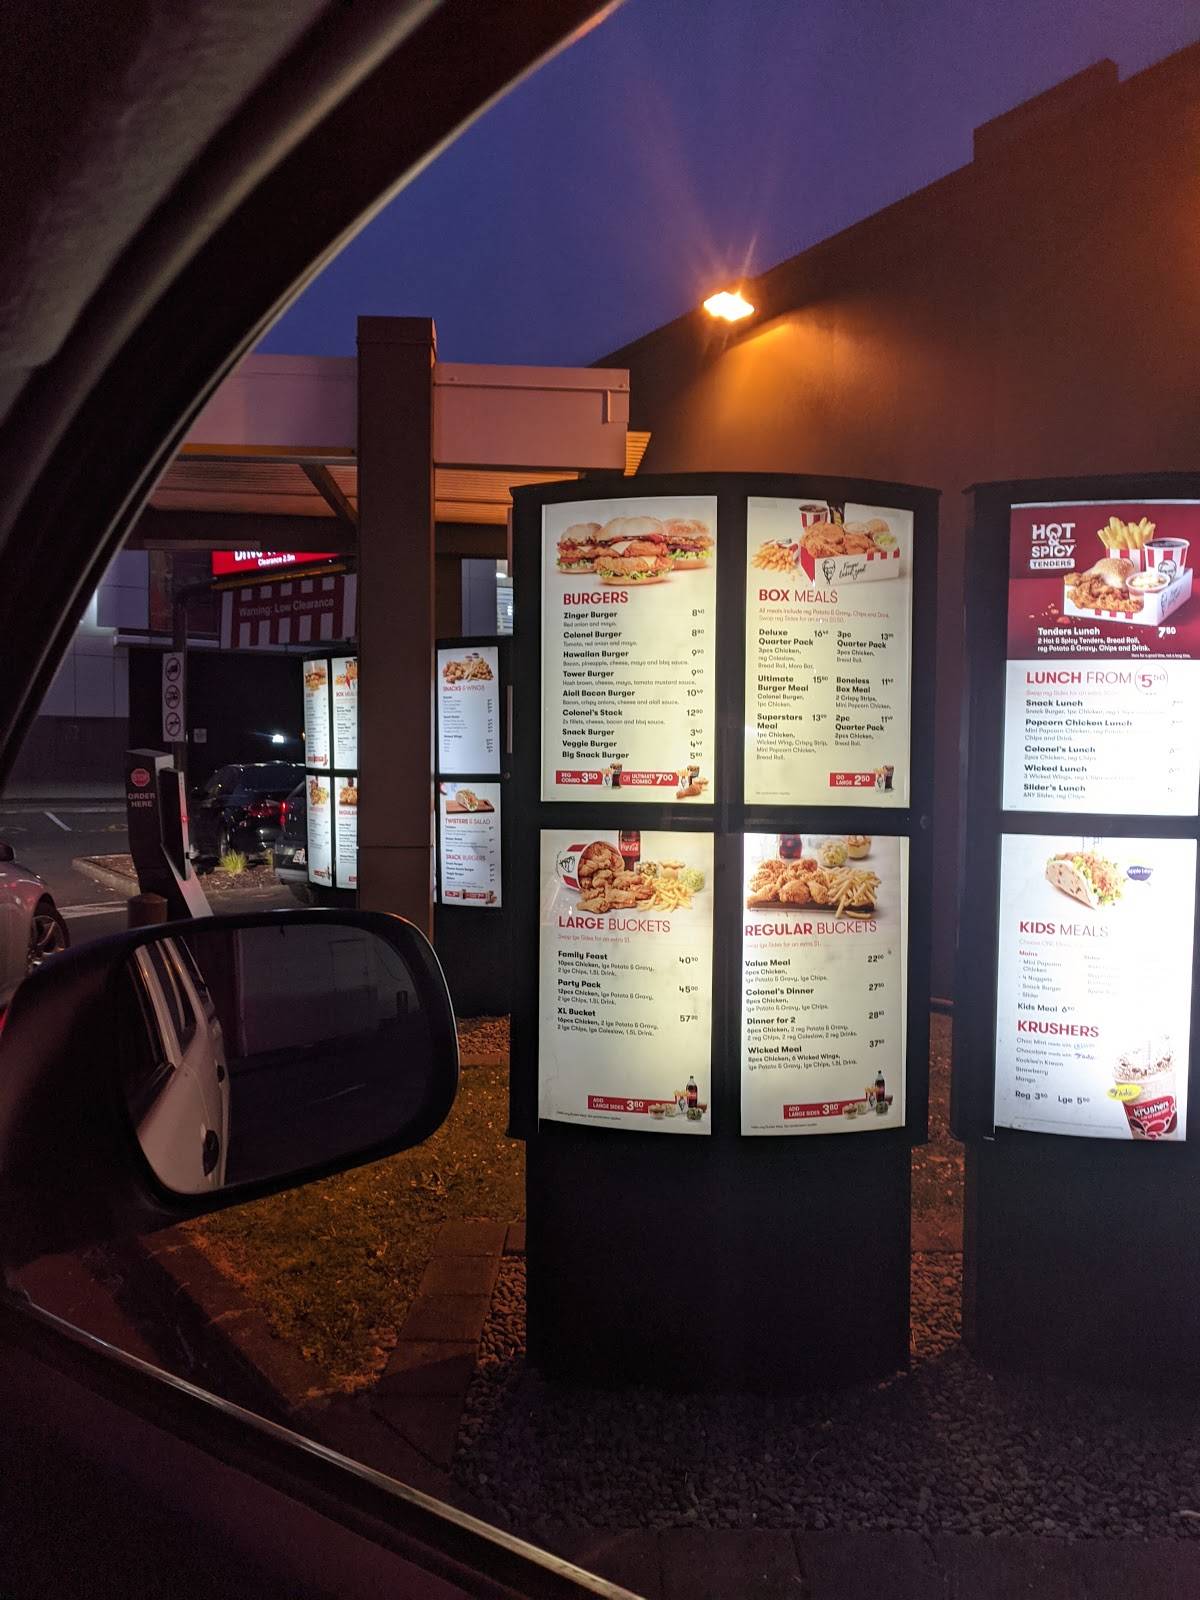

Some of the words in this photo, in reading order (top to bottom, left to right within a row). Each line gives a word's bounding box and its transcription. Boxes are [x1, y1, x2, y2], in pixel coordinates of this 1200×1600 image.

[1032, 523, 1075, 540] HOT
[1048, 532, 1060, 546] &
[1032, 545, 1074, 558] SPICY
[258, 555, 282, 566] Clearance
[563, 591, 629, 606] BURGERS
[759, 589, 790, 601] BOX
[794, 590, 838, 603] MEALS
[240, 606, 272, 617] Warning:
[274, 603, 292, 614] Low
[293, 598, 334, 610] Clearance
[602, 650, 629, 658] Burger
[588, 670, 614, 678] Burger
[1026, 672, 1081, 684] LUNCH
[1086, 672, 1131, 684] FROM
[1026, 719, 1063, 727] Popcorn
[559, 916, 604, 930] LARGE
[609, 918, 670, 933] BUCKETS
[745, 923, 812, 936] REGULAR
[818, 920, 877, 934] BUCKETS
[1019, 921, 1055, 935] KIDS
[1060, 924, 1108, 937] MEALS
[558, 950, 584, 960] Family
[586, 952, 607, 960] Feast
[558, 979, 580, 988] Party
[582, 980, 601, 988] Pack
[569, 1008, 596, 1016] Bucket
[1018, 1003, 1035, 1011] Kids
[1037, 1004, 1058, 1012] Meal
[1017, 1020, 1099, 1037] KRUSHERS
[1016, 1091, 1030, 1100] Reg
[1058, 1096, 1072, 1104] Lge
